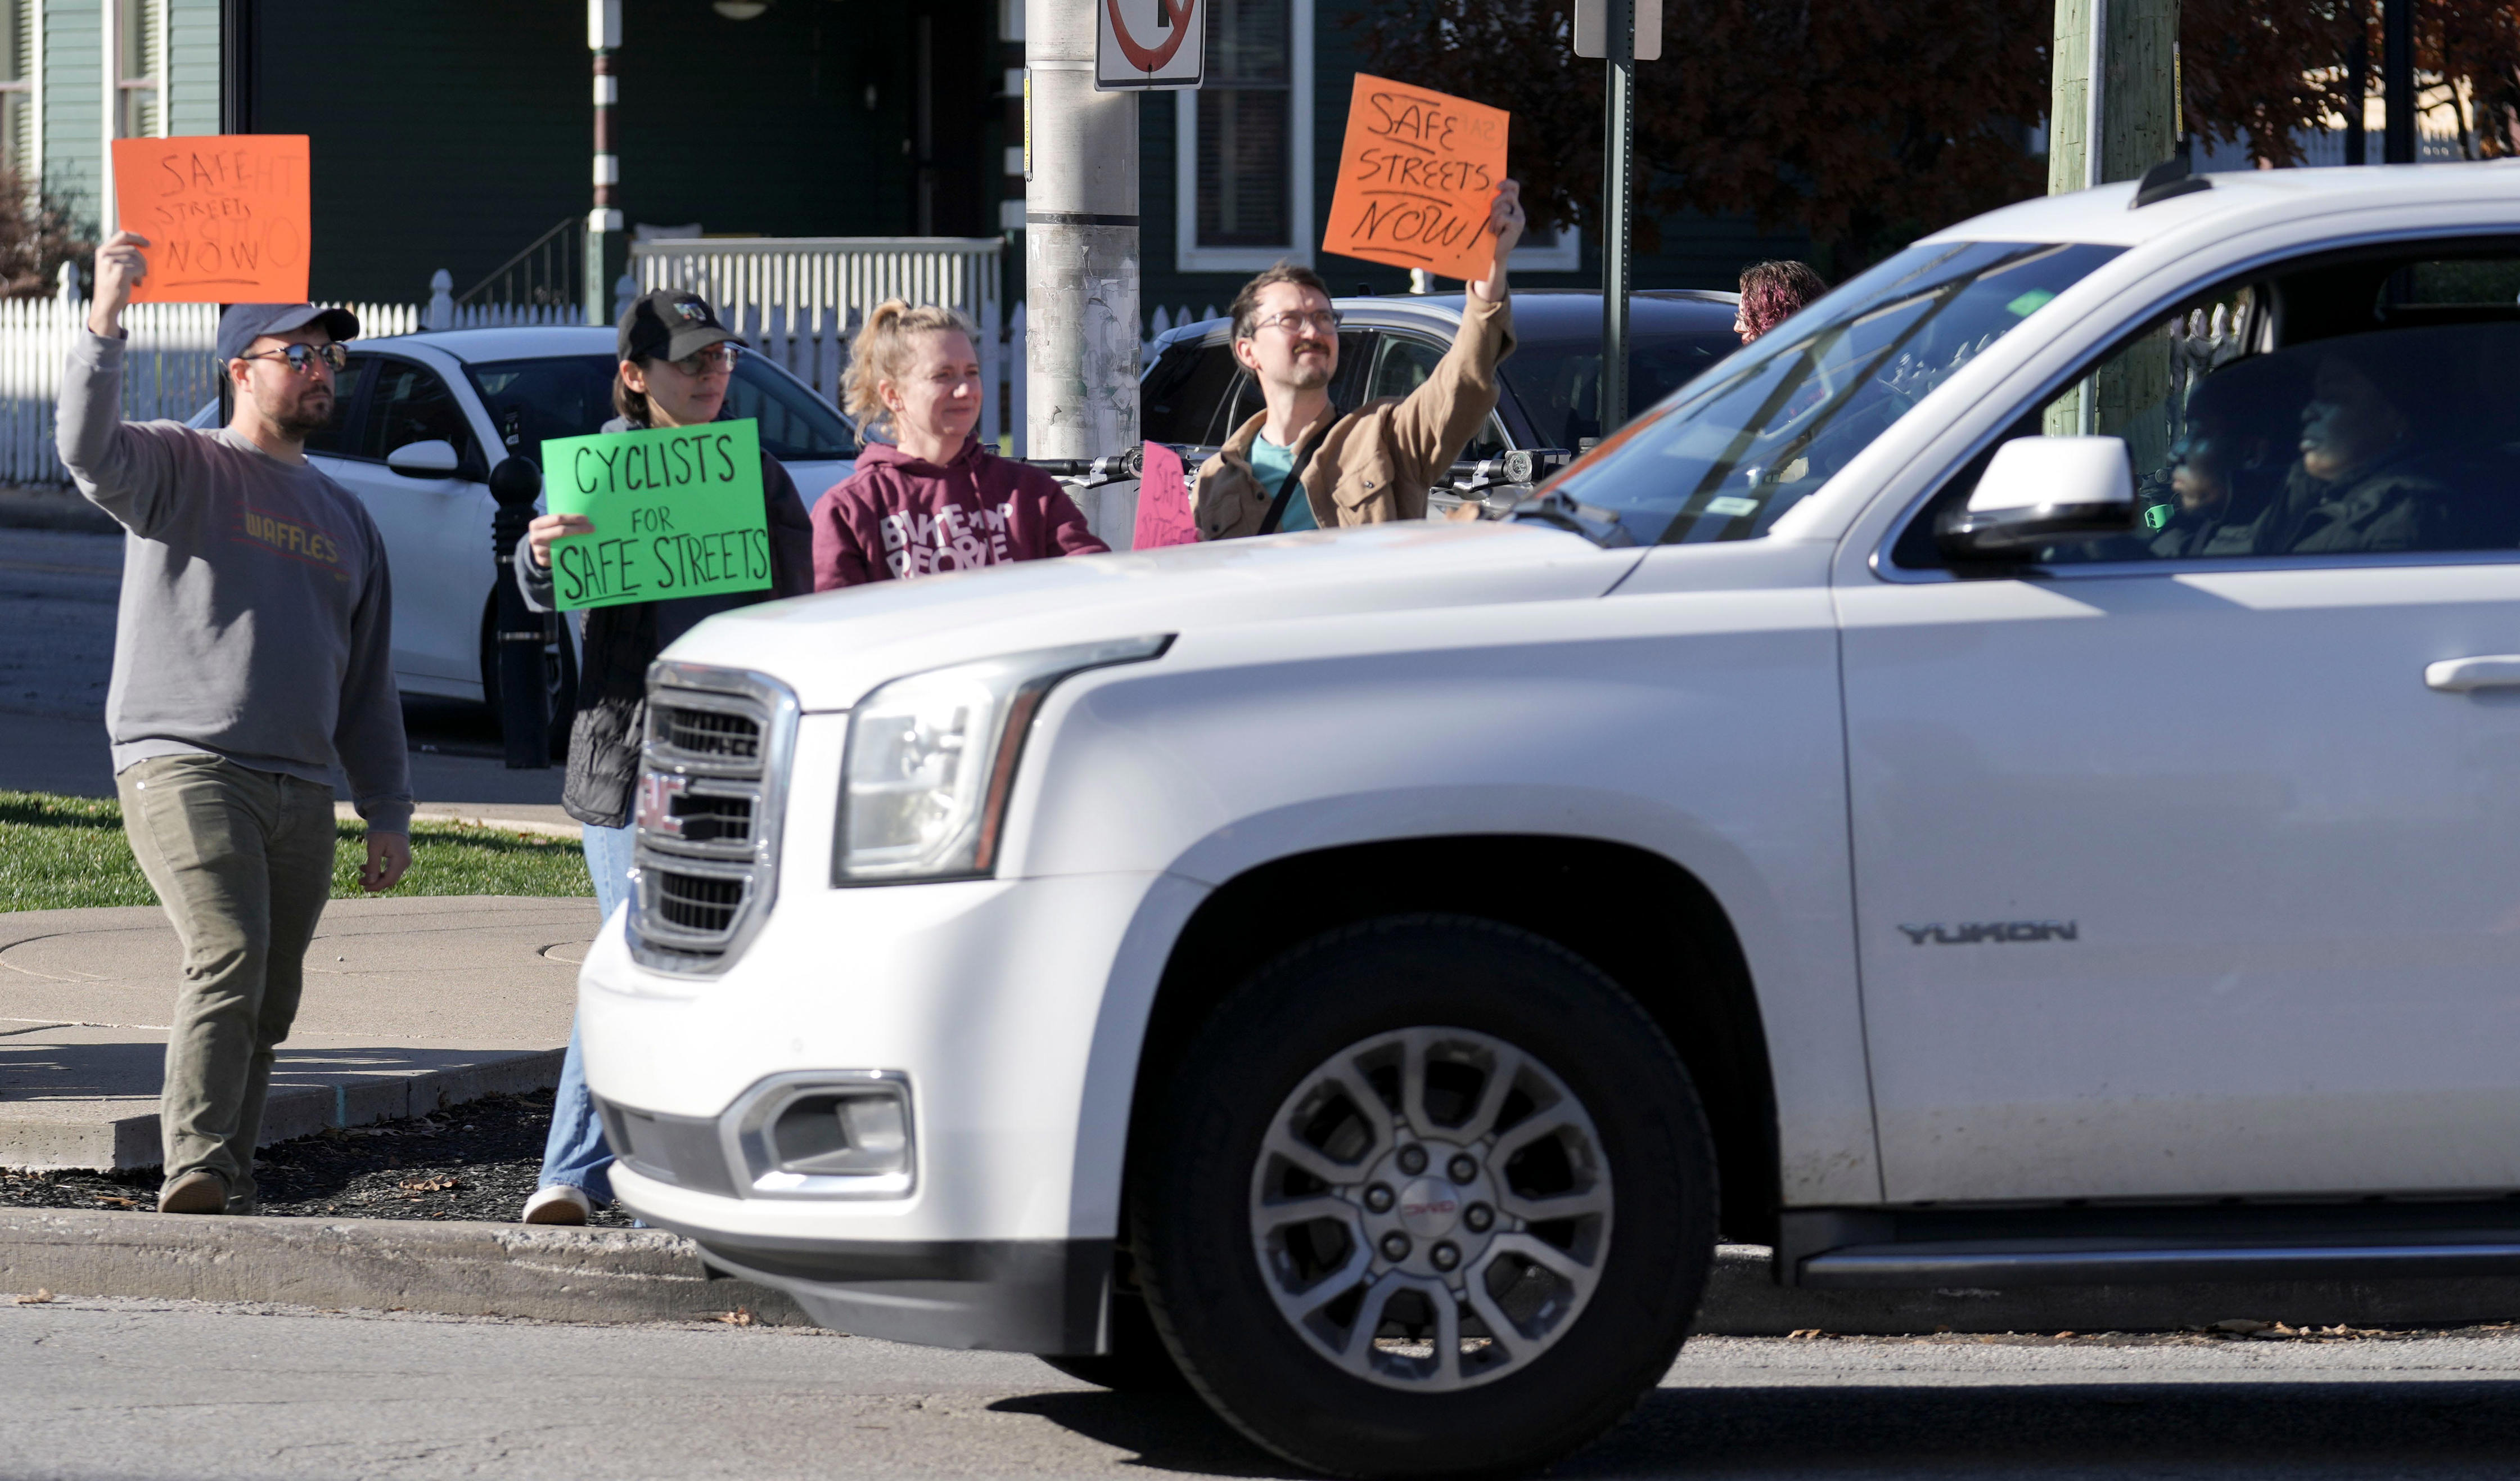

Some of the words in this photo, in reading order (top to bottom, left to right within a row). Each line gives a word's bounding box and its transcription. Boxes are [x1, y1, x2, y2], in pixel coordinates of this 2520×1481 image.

[1368, 92, 1458, 151] SAFE
[160, 148, 253, 197] SAFE
[1357, 148, 1490, 191] STREETS
[1351, 201, 1491, 259] NOW!
[166, 240, 259, 273] NOW
[575, 434, 736, 494] CYCLISTS
[246, 512, 339, 562] WAFFLES
[632, 506, 675, 534] FOR
[880, 504, 972, 552] BIKE
[560, 539, 642, 600] SAFE
[653, 529, 768, 589] STREETS
[1897, 920, 2079, 946] YUKON
